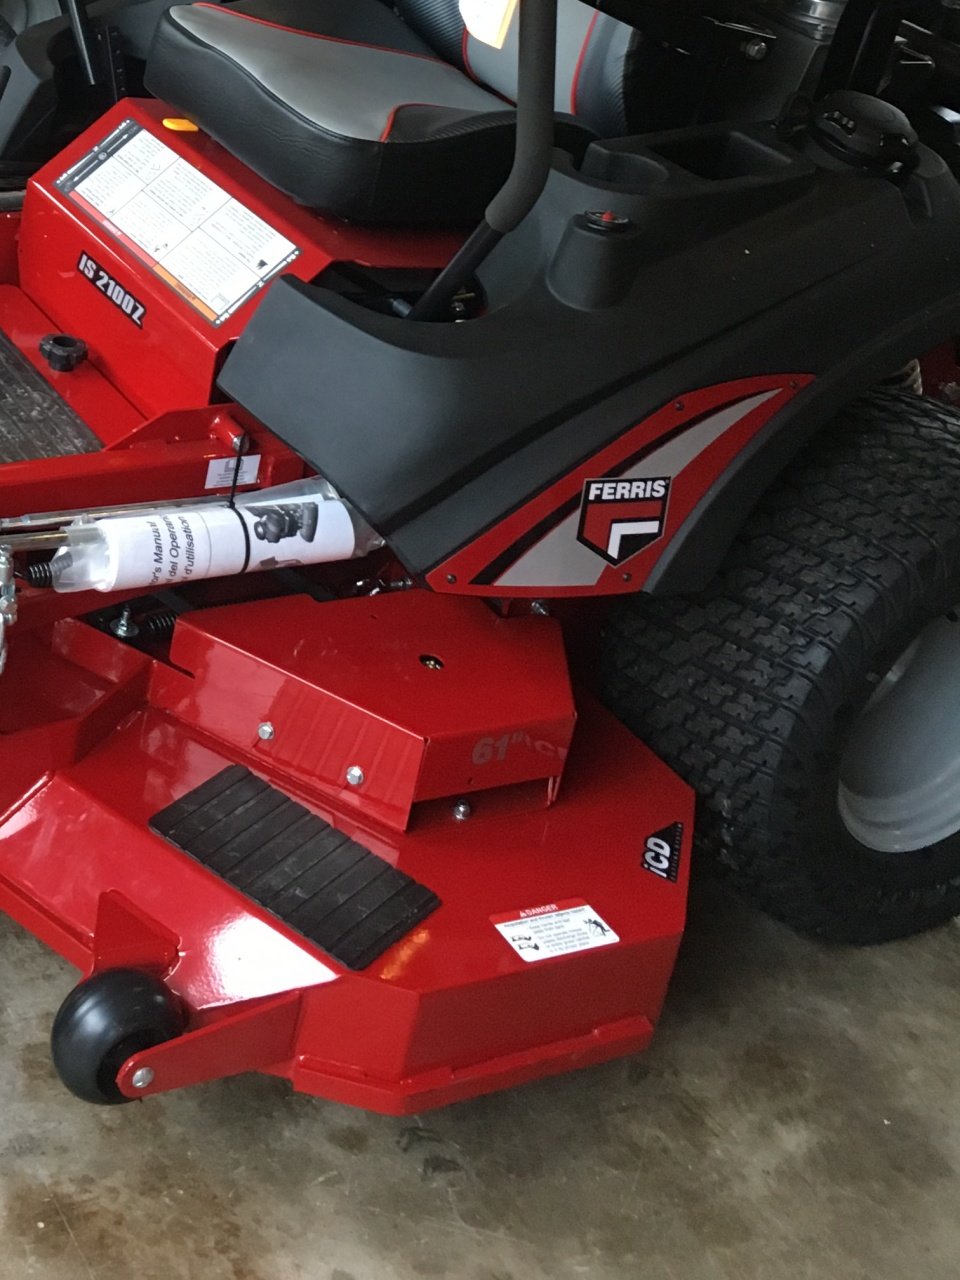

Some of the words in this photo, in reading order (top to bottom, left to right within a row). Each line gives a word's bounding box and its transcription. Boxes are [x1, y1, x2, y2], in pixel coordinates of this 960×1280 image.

[78, 253, 97, 280] IS
[95, 270, 145, 326] 2100Z
[587, 479, 667, 501] FERRIS
[168, 561, 178, 577] del
[643, 836, 671, 878] iCD
[525, 903, 559, 916] DANGER
